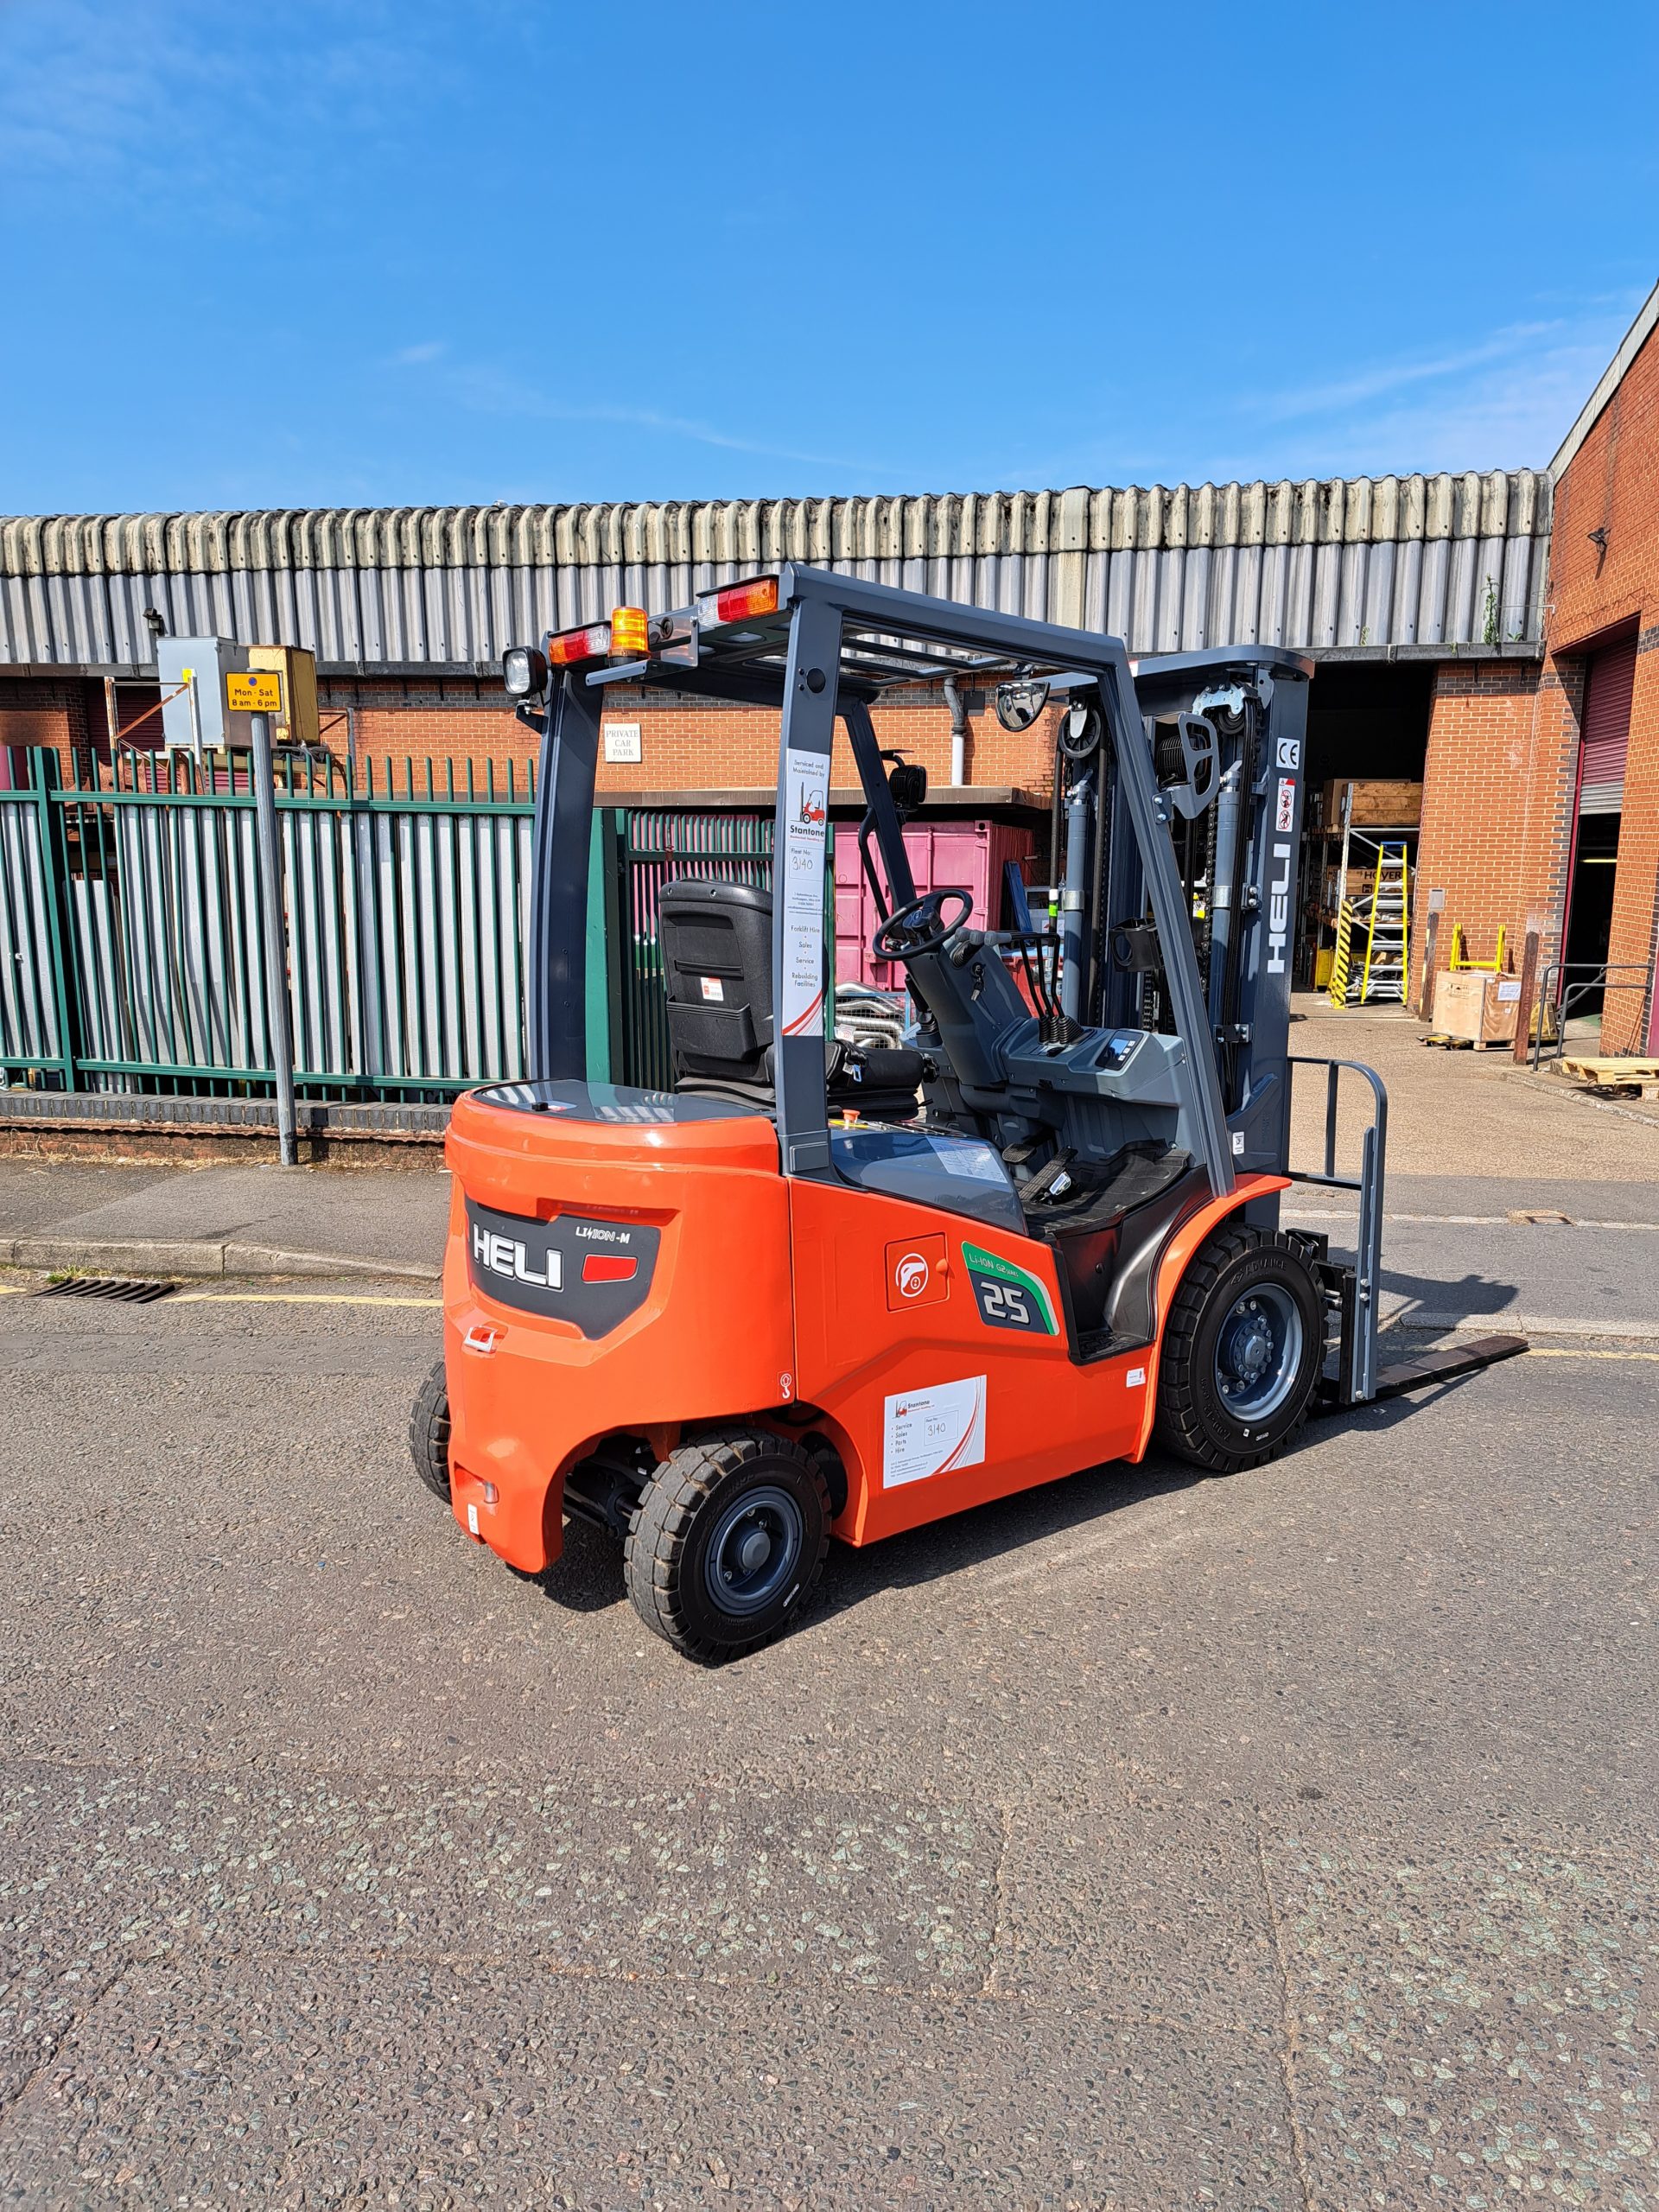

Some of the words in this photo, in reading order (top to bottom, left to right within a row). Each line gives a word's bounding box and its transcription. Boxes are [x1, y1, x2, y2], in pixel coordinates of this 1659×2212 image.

[606, 729, 639, 738] PRIVATE
[614, 739, 631, 747] CAR
[1279, 741, 1298, 766] CE
[794, 760, 814, 768] Serviced
[792, 766, 818, 776] Maintained
[790, 824, 825, 837] Stantone
[791, 855, 814, 871] 3140
[1267, 843, 1291, 974] HELI
[791, 925, 809, 933] Forklift
[791, 972, 818, 982] Rebuilding
[474, 1223, 564, 1293] HELI
[980, 1281, 1031, 1325] 25
[907, 1400, 931, 1409] Stantone
[895, 1422, 912, 1431] Service
[927, 1422, 946, 1437] 3140
